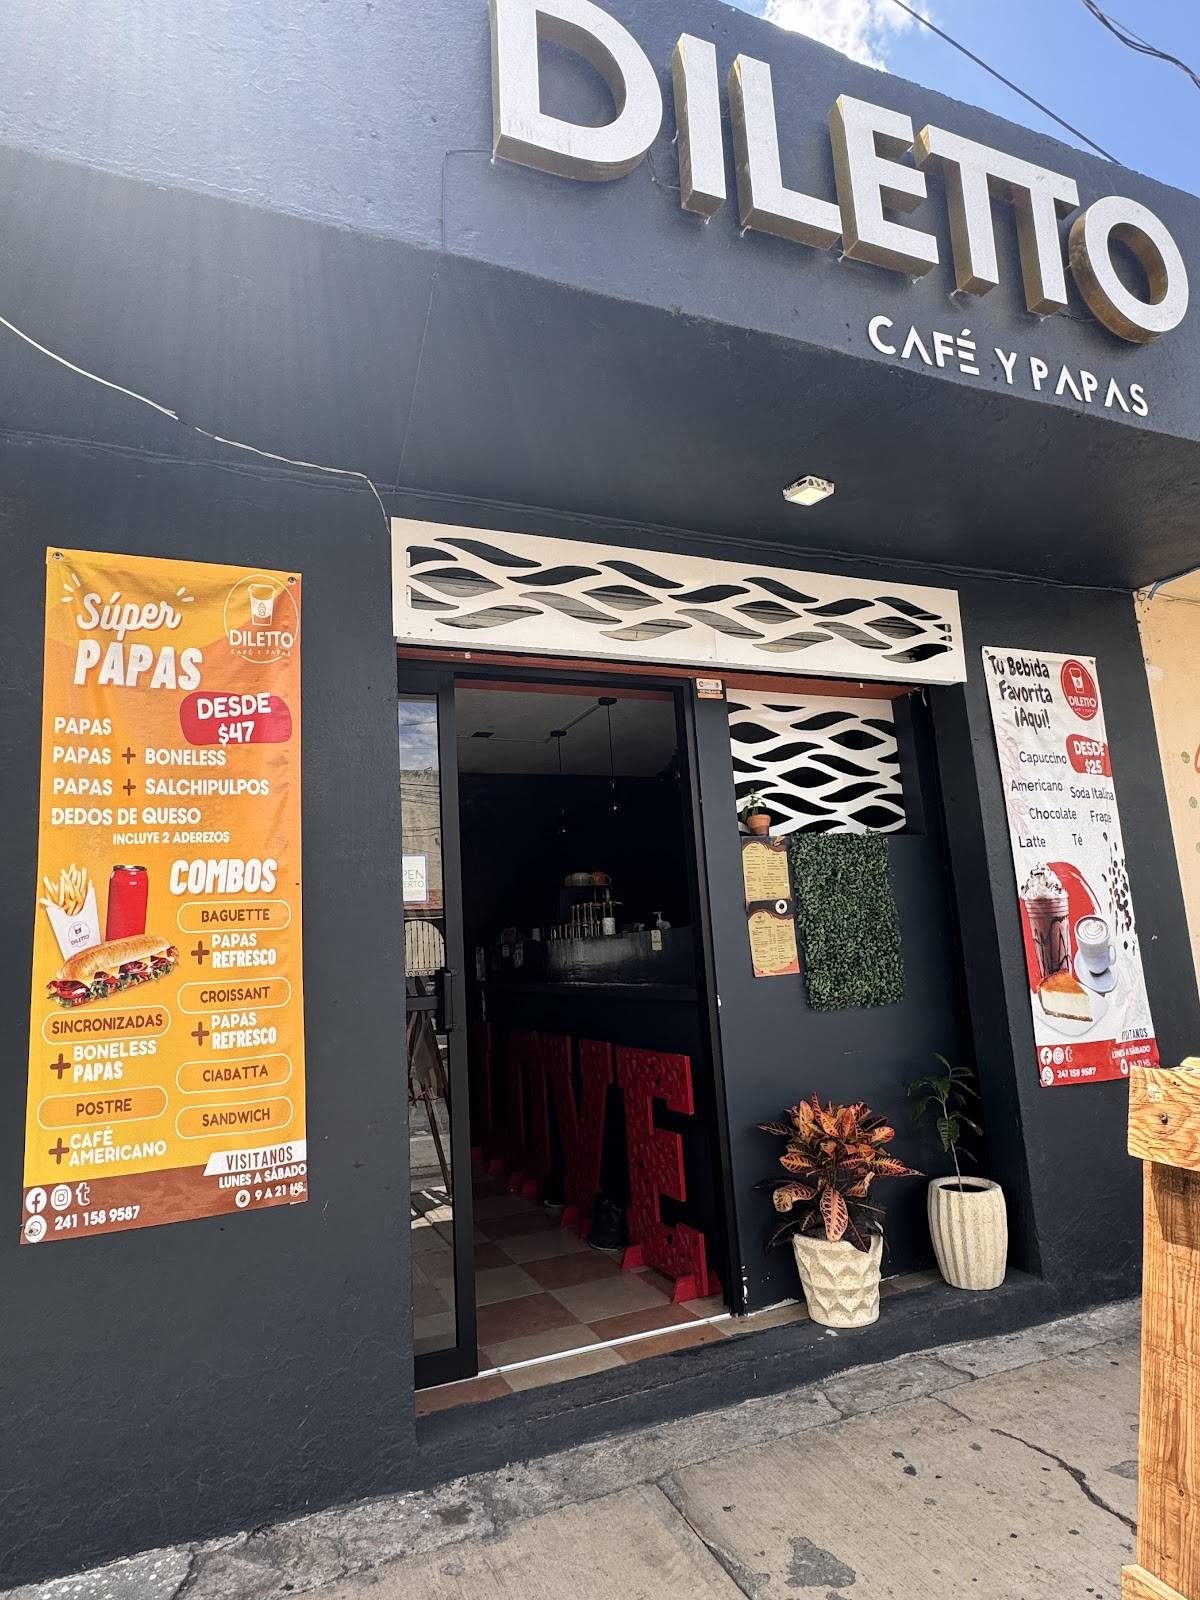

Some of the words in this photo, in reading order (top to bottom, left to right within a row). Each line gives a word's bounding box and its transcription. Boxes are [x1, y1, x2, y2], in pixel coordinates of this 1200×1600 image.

[492, 0, 1190, 344] DILETTO
[868, 315, 980, 376] CAFÉ
[994, 348, 1017, 384] Y
[1029, 356, 1149, 417] PAPAS
[76, 591, 182, 641] Súper
[229, 629, 294, 649] DILETTO
[73, 639, 203, 691] PAPAS
[988, 655, 1005, 676] Tu
[1008, 656, 1050, 679] Bebida
[999, 680, 1053, 704] Favorita
[1068, 695, 1097, 708] DILETTO
[196, 692, 272, 720] DESDE
[53, 716, 112, 736] PAPAS
[217, 720, 255, 747] $47
[52, 746, 111, 765] PAPAS
[144, 748, 226, 767] BONELESS
[1019, 751, 1068, 765] Capuccino
[1073, 740, 1105, 757] DESDE
[1085, 758, 1103, 775] $25
[52, 777, 113, 796] PAPAS
[144, 778, 270, 796] SALCHIPULPOS
[1011, 779, 1064, 793] Americano
[1070, 786, 1091, 799] Soda
[50, 808, 113, 826] DEDOS
[117, 809, 137, 825] DE
[141, 808, 201, 825] QUESO
[1029, 807, 1077, 821] Chocolate
[112, 833, 160, 845] INCLUYE
[162, 833, 170, 844] 2
[173, 832, 230, 844] ADEREZOS
[1018, 836, 1046, 849] Latte
[1072, 834, 1083, 847] Té
[169, 858, 278, 895] COMBOS
[201, 908, 270, 923] BAGUETTE
[211, 933, 257, 949] PAPAS
[212, 948, 277, 969] REFRESCO
[199, 986, 271, 1004] CROISSANT
[51, 1013, 163, 1035] SINCRONIZADAS
[211, 1012, 257, 1029] PAPAS
[211, 1027, 277, 1050] REFRESCO
[73, 1040, 157, 1061] BONELESS
[73, 1061, 124, 1083] PAPAS
[202, 1064, 269, 1082] CIABATTA
[1057, 1069, 1069, 1079] 241
[75, 1098, 133, 1117] POSTRE
[201, 1108, 271, 1127] SANDWICH
[70, 1126, 113, 1149] CAFÉ
[68, 1140, 167, 1168] AMERICANO
[226, 1146, 293, 1171] VISITANOS
[219, 1173, 252, 1189] LUNES
[254, 1172, 262, 1184] A
[264, 1163, 308, 1183] SÁBADO
[255, 1190, 263, 1201] 9
[264, 1187, 273, 1200] A
[275, 1185, 287, 1198] 21
[54, 1213, 79, 1231] 241
[83, 1209, 107, 1226] 158
[109, 1205, 141, 1223] 9587
